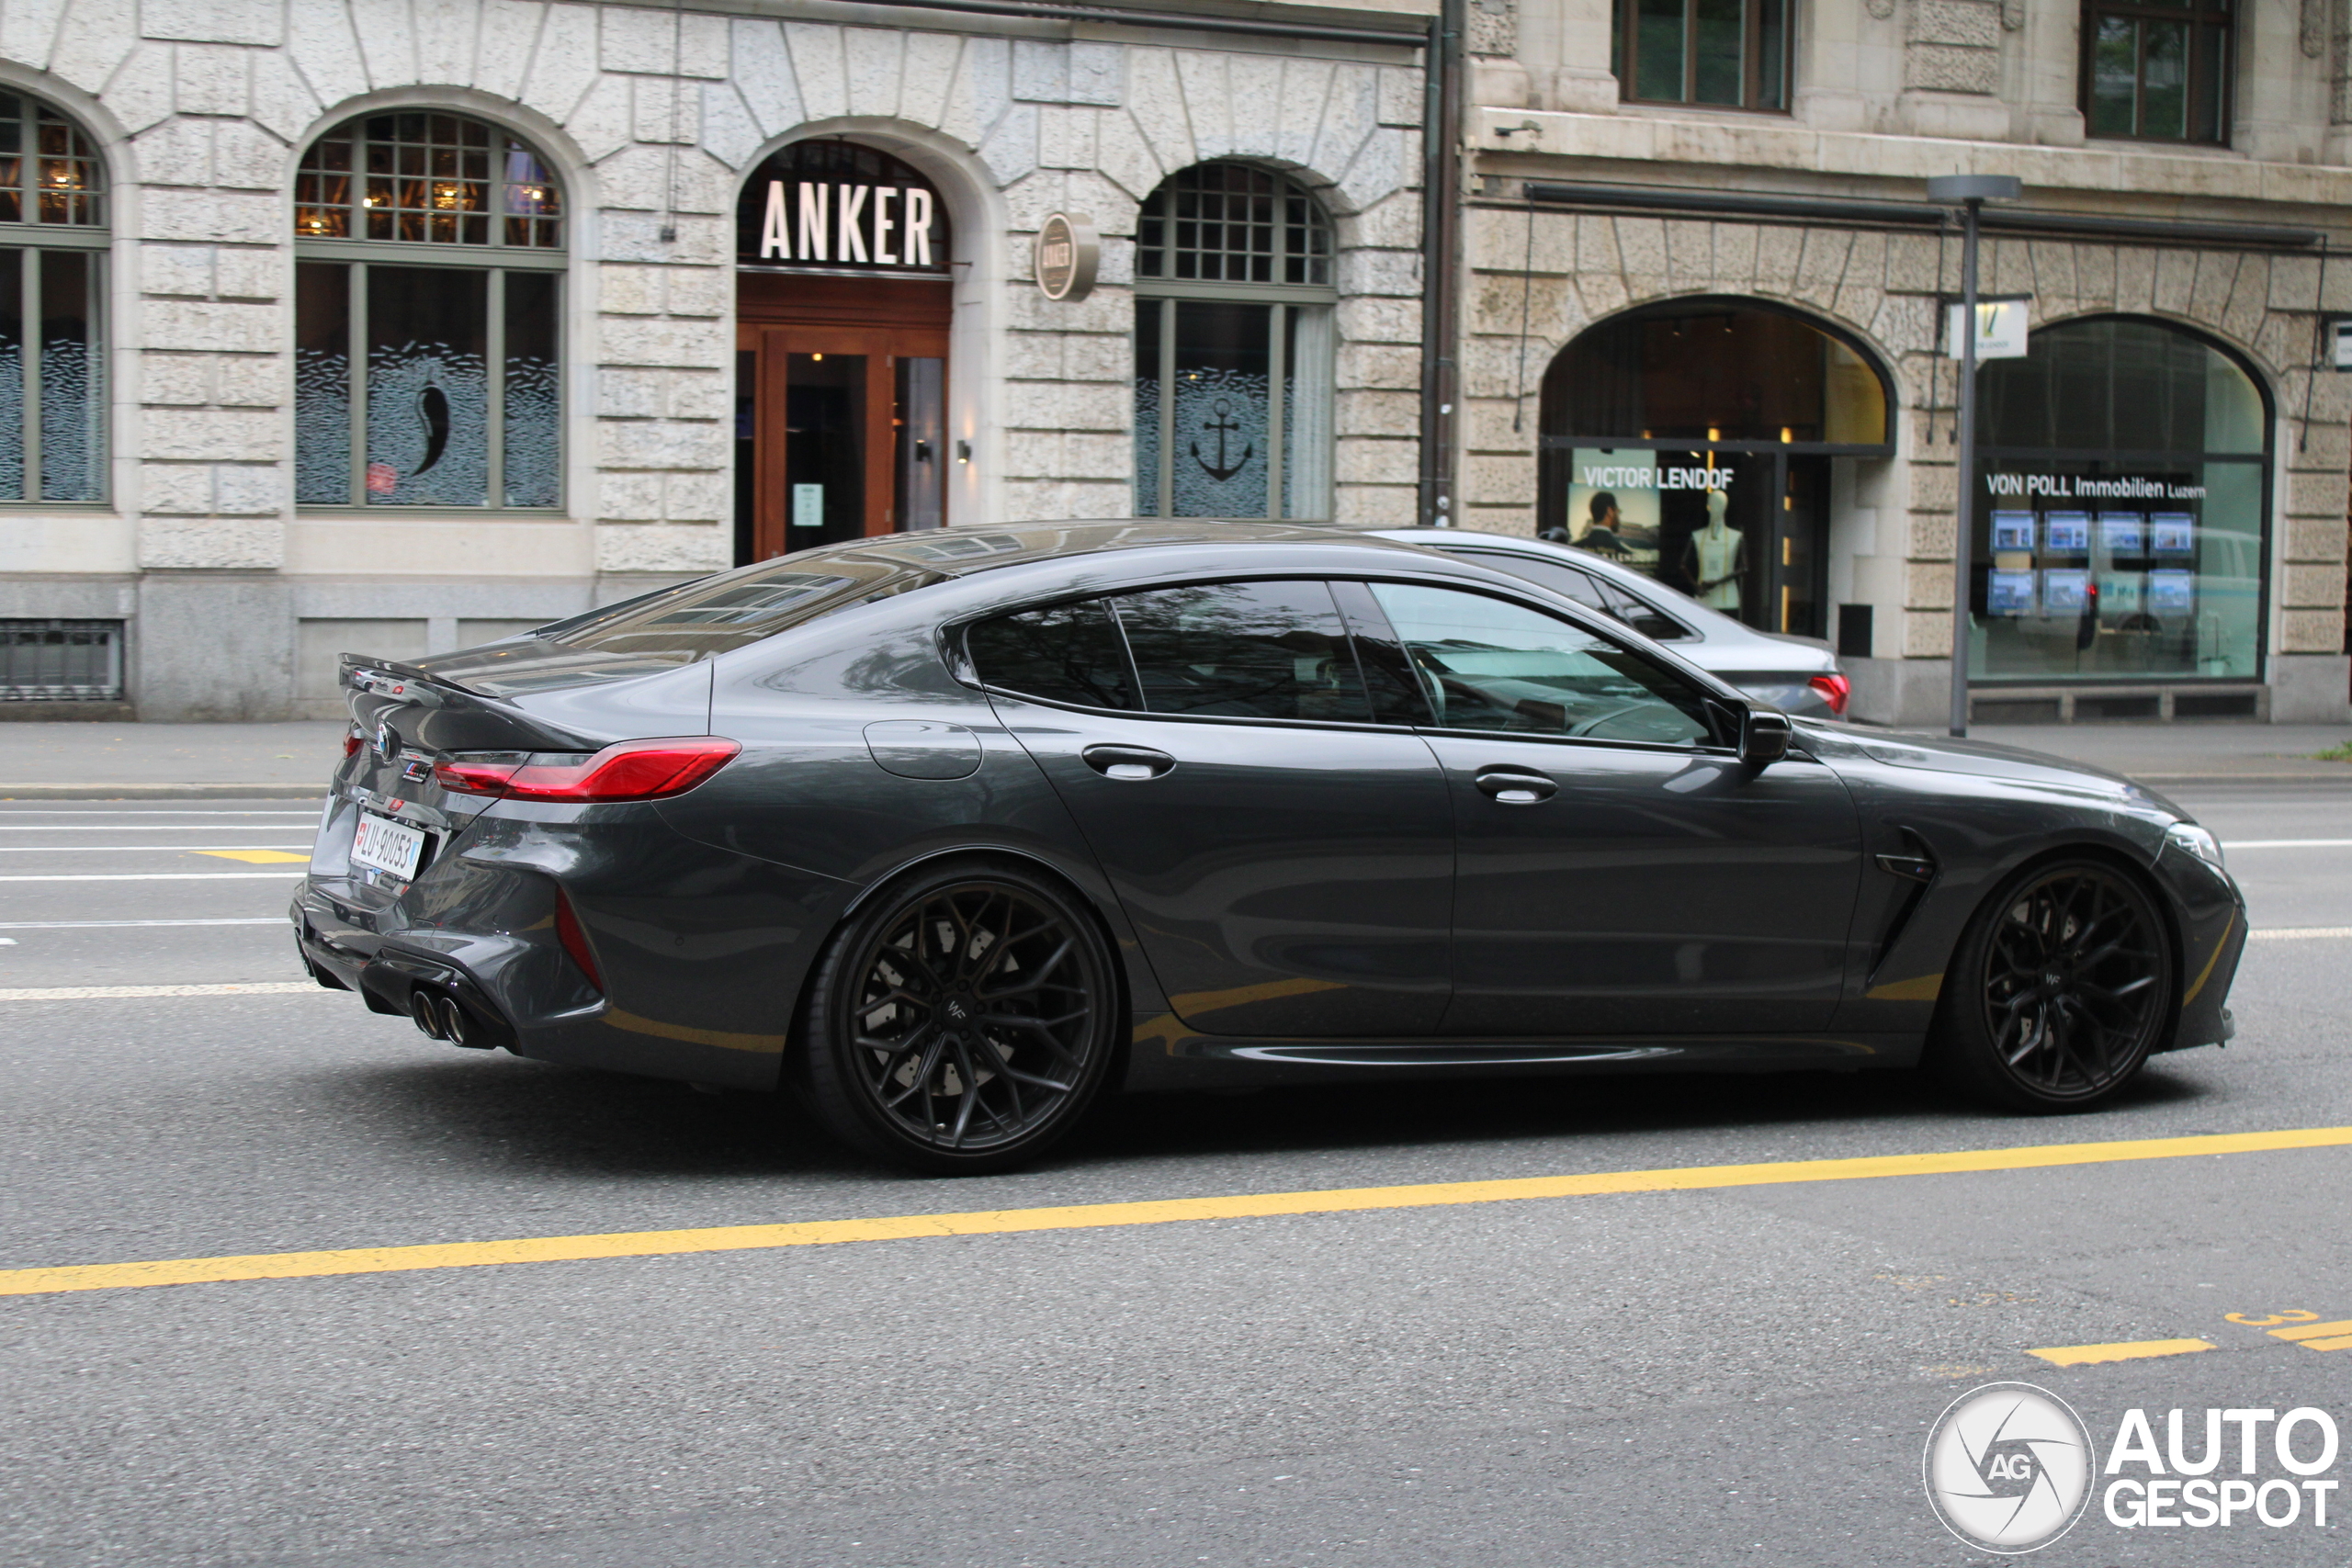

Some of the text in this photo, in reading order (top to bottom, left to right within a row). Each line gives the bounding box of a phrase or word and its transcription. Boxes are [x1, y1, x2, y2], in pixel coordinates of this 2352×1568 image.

[760, 180, 933, 265] ANKER
[1583, 466, 1735, 490] VICTOR LENDOF
[1986, 473, 2206, 499] VON POLL Immobilien Luzern
